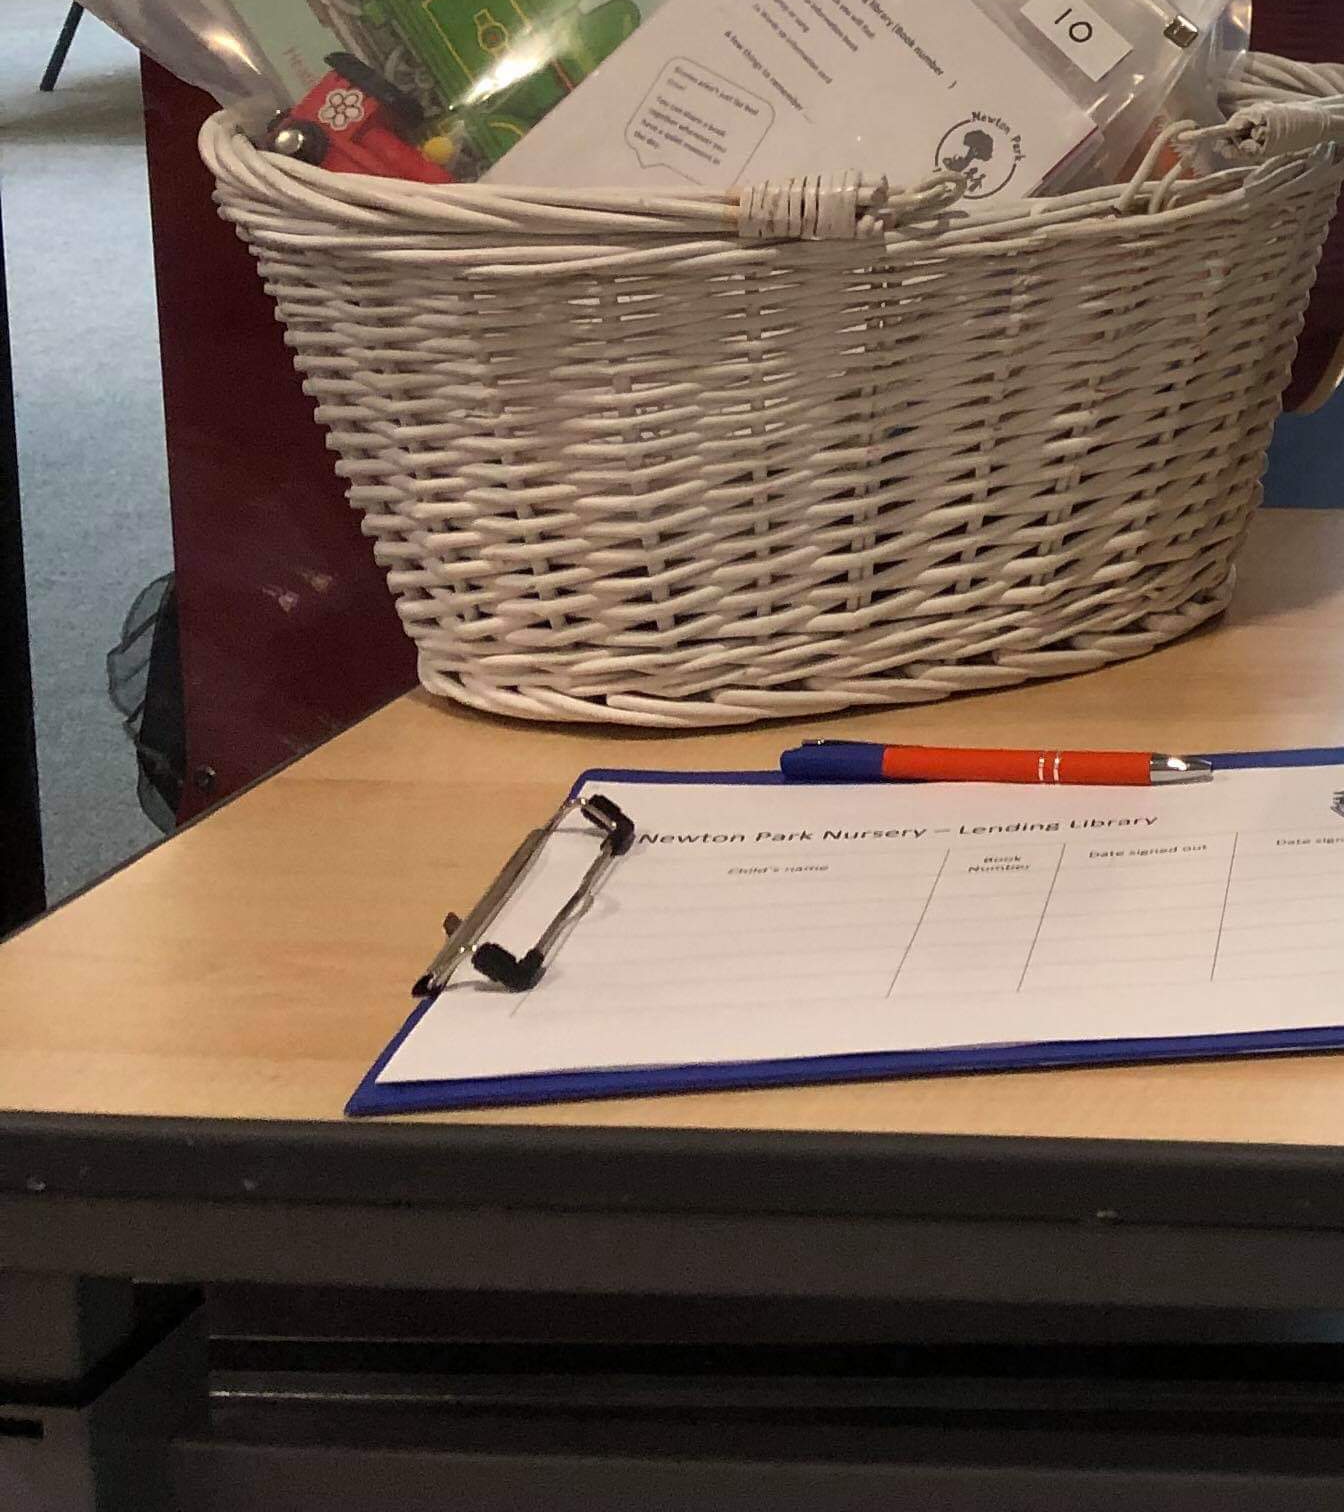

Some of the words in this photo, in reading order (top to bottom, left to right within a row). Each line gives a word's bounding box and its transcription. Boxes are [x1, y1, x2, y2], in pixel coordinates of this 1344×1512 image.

[1053, 7, 1094, 44] 10
[637, 832, 746, 845] Newton
[755, 829, 813, 842] Park
[823, 829, 926, 842] Nursery
[959, 822, 1060, 835] Lending
[1069, 816, 1158, 829] Library
